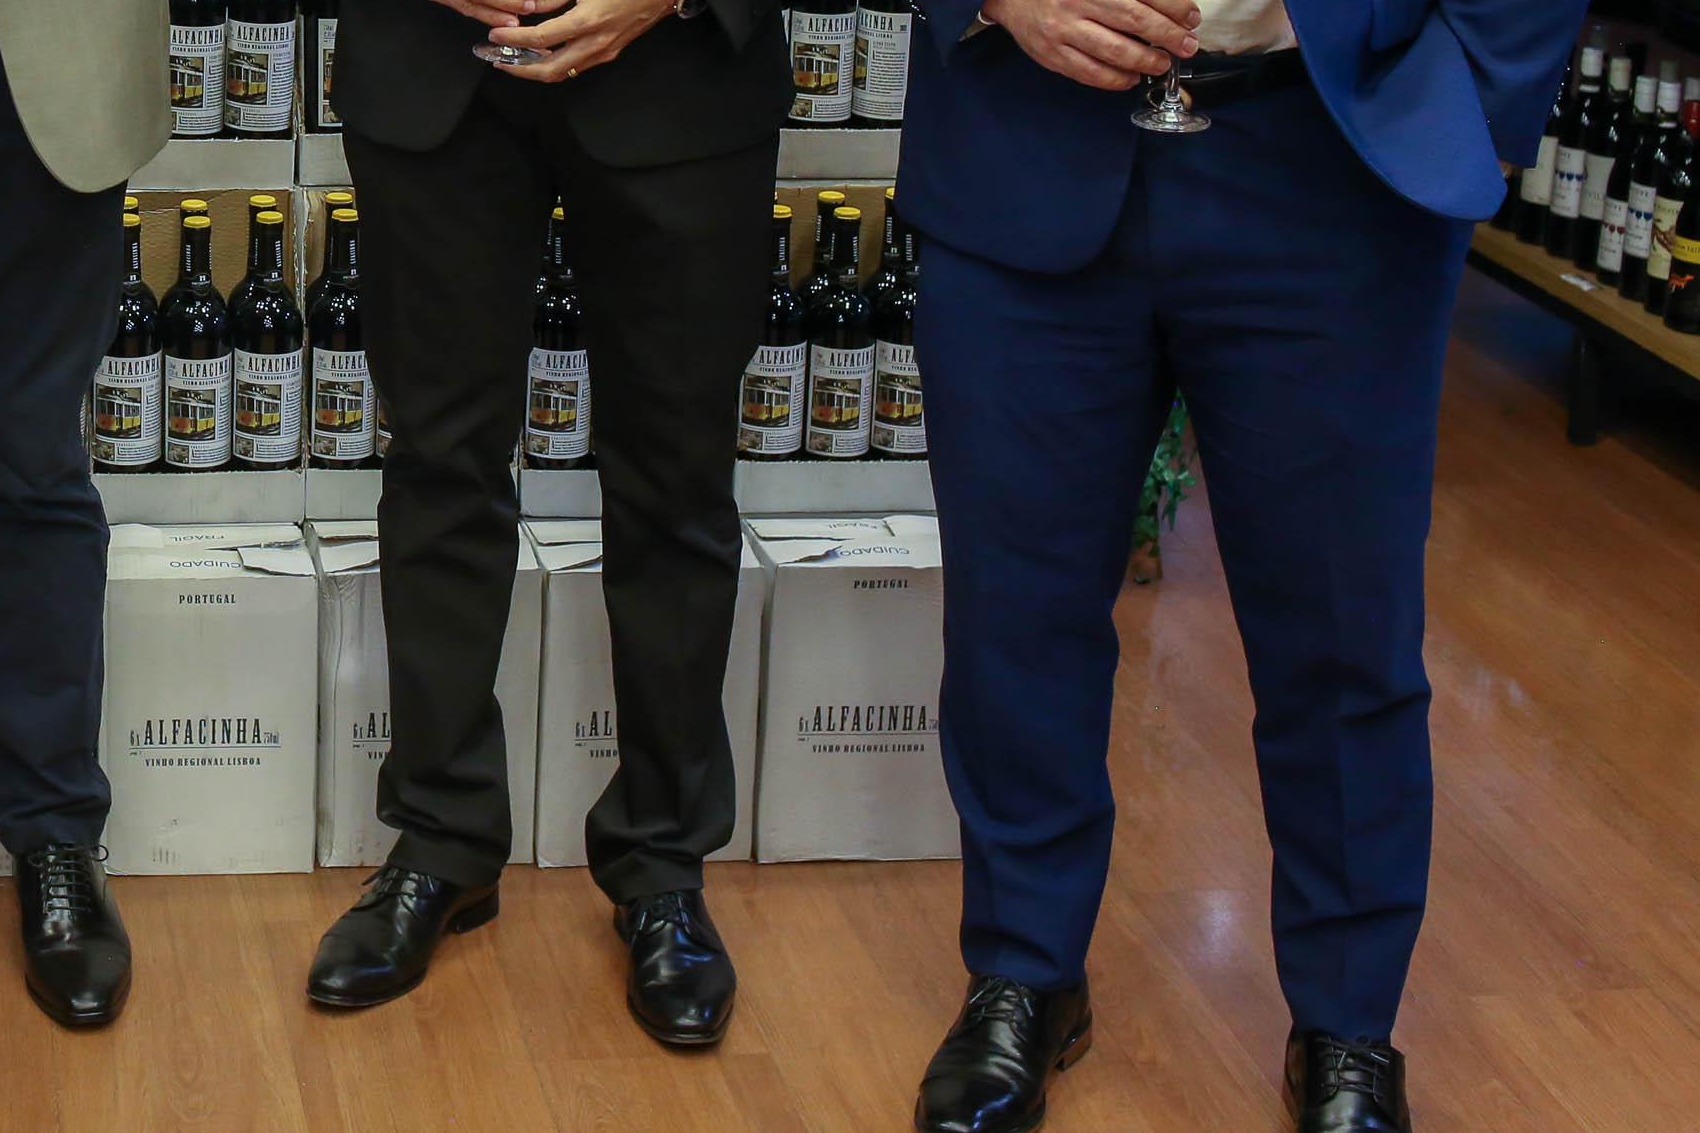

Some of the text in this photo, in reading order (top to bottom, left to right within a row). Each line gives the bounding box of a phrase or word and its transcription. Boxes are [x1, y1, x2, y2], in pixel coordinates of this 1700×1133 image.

[171, 28, 223, 45] ALFACINHA
[236, 25, 290, 42] ALFACINHA
[545, 353, 587, 369] ALFACIN
[840, 546, 909, 556] CUIDADO
[169, 560, 241, 568] CUIDADO
[854, 579, 908, 589] PORTUGAL
[179, 594, 236, 604] PORTUGAL
[812, 705, 927, 732] ALFACINHA
[144, 718, 262, 745] ALFACINHA
[812, 744, 841, 753] VINHO
[843, 744, 889, 753] REGIONAL
[145, 757, 261, 767] VINHO REGIONAL LISBOA
